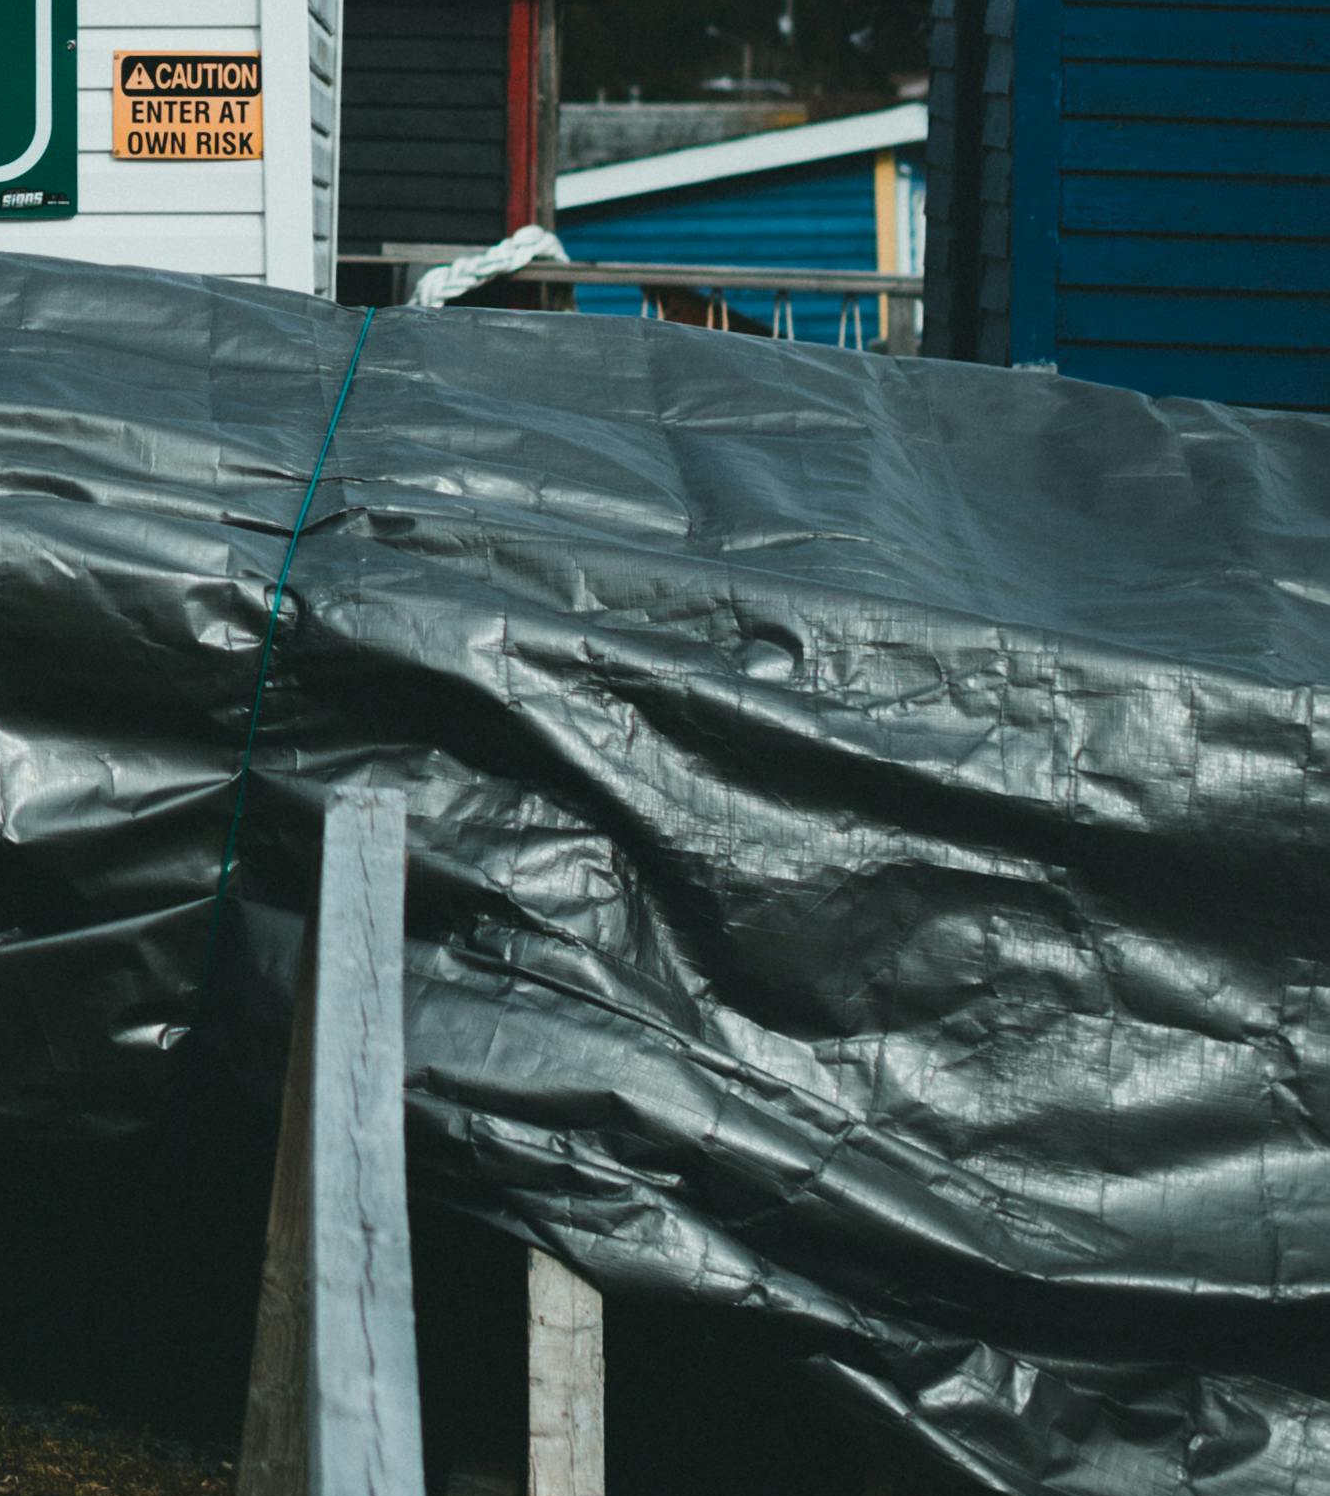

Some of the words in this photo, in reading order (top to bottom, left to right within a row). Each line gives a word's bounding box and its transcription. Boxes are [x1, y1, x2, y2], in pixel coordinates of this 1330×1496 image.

[155, 62, 258, 90] CAUTION
[131, 100, 210, 124] ENTER
[219, 100, 250, 124] AT
[127, 131, 186, 155] OWN
[196, 131, 253, 155] RISK
